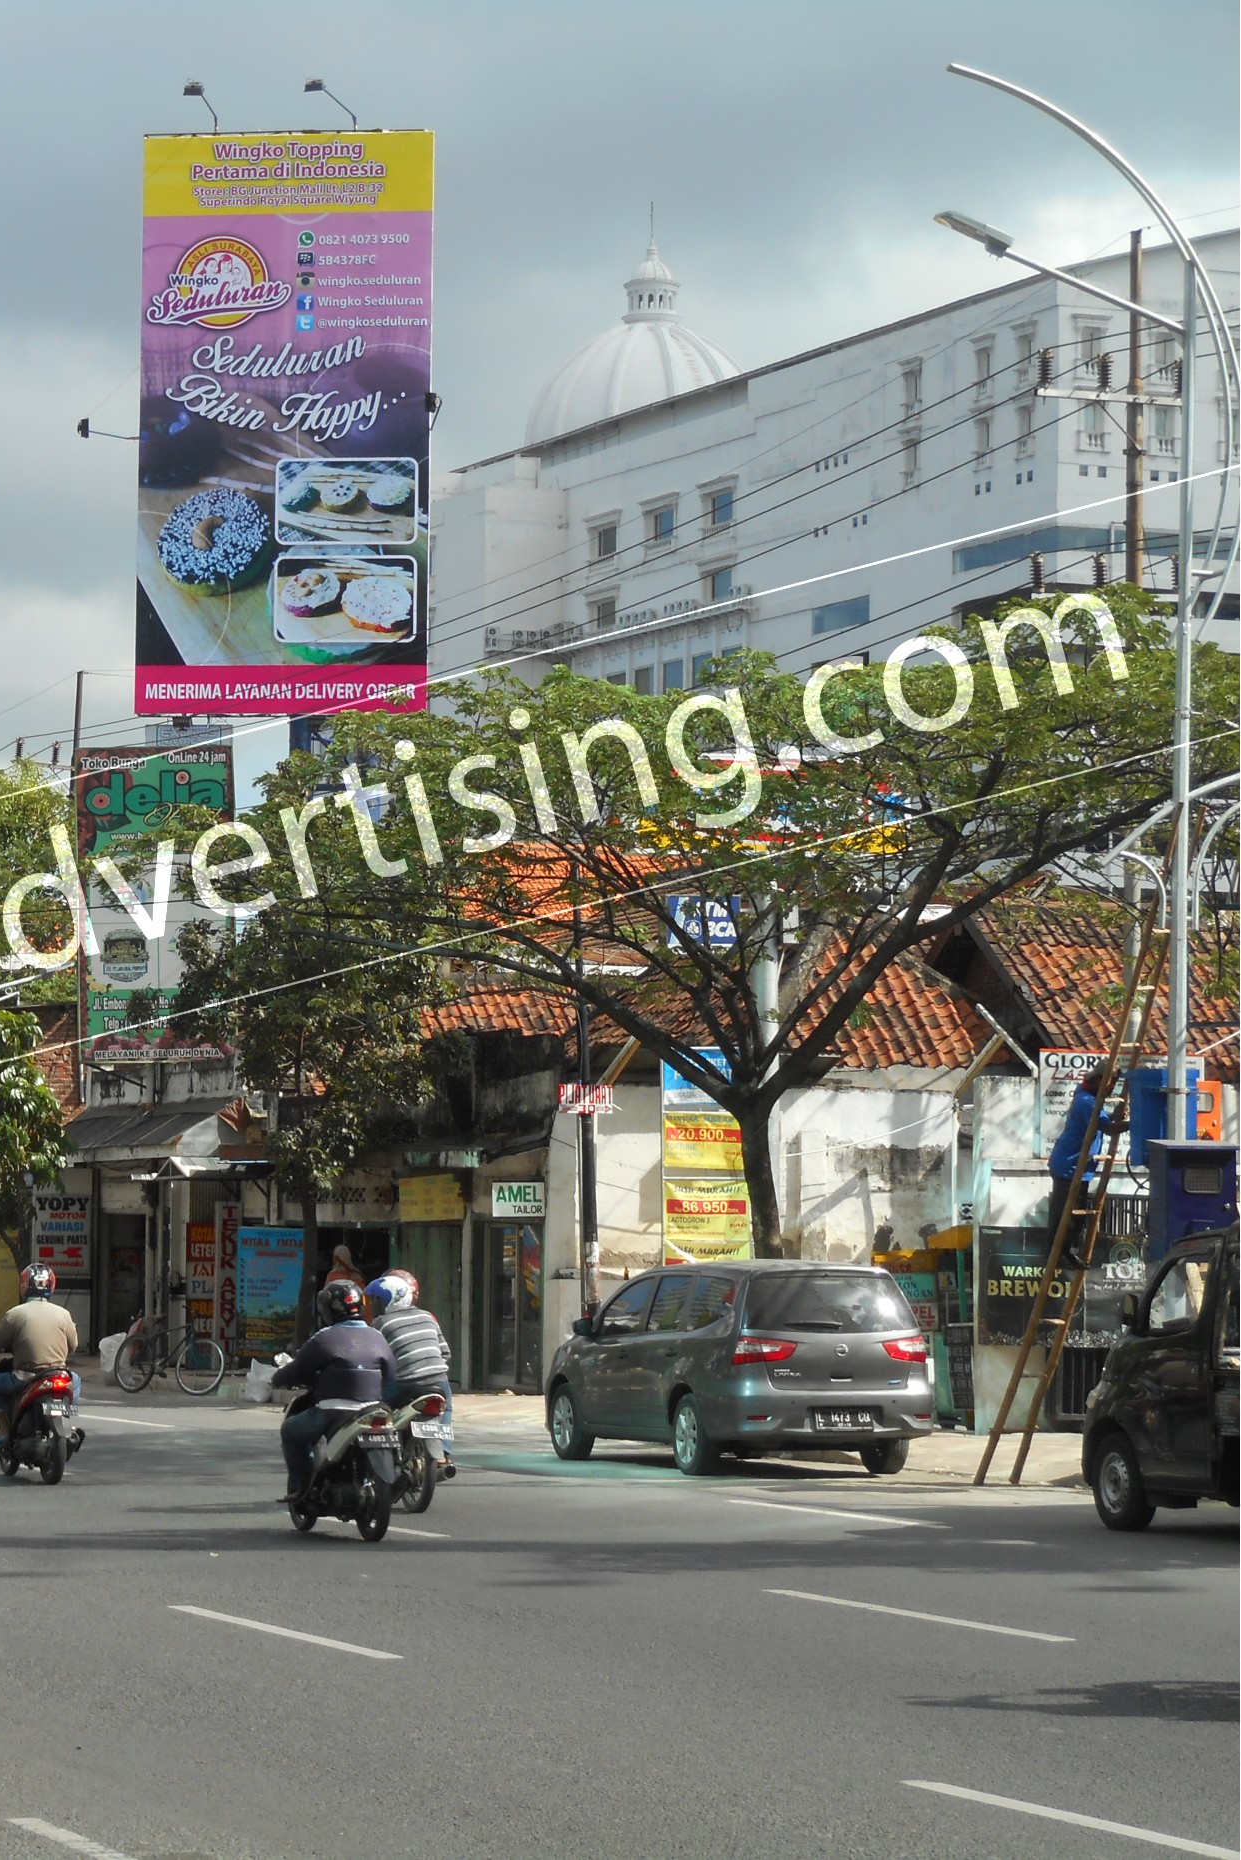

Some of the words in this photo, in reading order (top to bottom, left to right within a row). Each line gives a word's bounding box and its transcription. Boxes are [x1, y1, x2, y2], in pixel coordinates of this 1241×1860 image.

[214, 142, 284, 162] Wingko
[288, 141, 363, 160] Topping
[192, 164, 268, 180] Pertama
[273, 163, 290, 178] di
[295, 163, 385, 177] Indonesia
[232, 186, 246, 195] BG
[248, 185, 296, 196] Junction
[300, 184, 324, 193] Mall
[342, 184, 356, 192] L2
[199, 197, 258, 207] Superindo
[260, 196, 290, 207] Royal
[293, 196, 331, 206] Square
[333, 194, 377, 205] Wiyung
[319, 234, 346, 244] 0821
[350, 234, 377, 244] 4073
[381, 234, 409, 243] 9500
[188, 247, 208, 268] ASLI
[213, 242, 260, 276] SURABAYA
[170, 274, 219, 287] Wingko
[318, 275, 421, 287] wingko.seduluran
[148, 281, 291, 322] Seduluran
[318, 296, 361, 307] Wingko
[364, 295, 423, 307] Seduluran
[318, 317, 428, 329] @wingkoseduluran
[192, 336, 366, 378] Seduluran
[166, 374, 266, 430] Bikin
[145, 684, 221, 699] MENERIMA
[226, 684, 291, 700] LAYANAN
[296, 684, 363, 700] DELIVERY
[81, 758, 109, 769] Toko
[111, 757, 146, 771] Bunga
[168, 752, 198, 763] OnLine
[198, 752, 210, 763] 24
[210, 752, 226, 765] jam
[85, 770, 230, 815] delia
[708, 921, 737, 937] BCA
[95, 1051, 137, 1059] MELAYANI
[153, 1049, 191, 1057] SELURUH
[678, 1129, 724, 1140] 20.900
[496, 1185, 542, 1203] AMEL
[36, 1197, 90, 1211] YOPY
[512, 1205, 543, 1214] TAILOR
[682, 1201, 728, 1213] 86.950
[41, 1221, 84, 1232] VARIASI
[37, 1235, 65, 1245] GENUINE
[67, 1235, 88, 1245] PARTS
